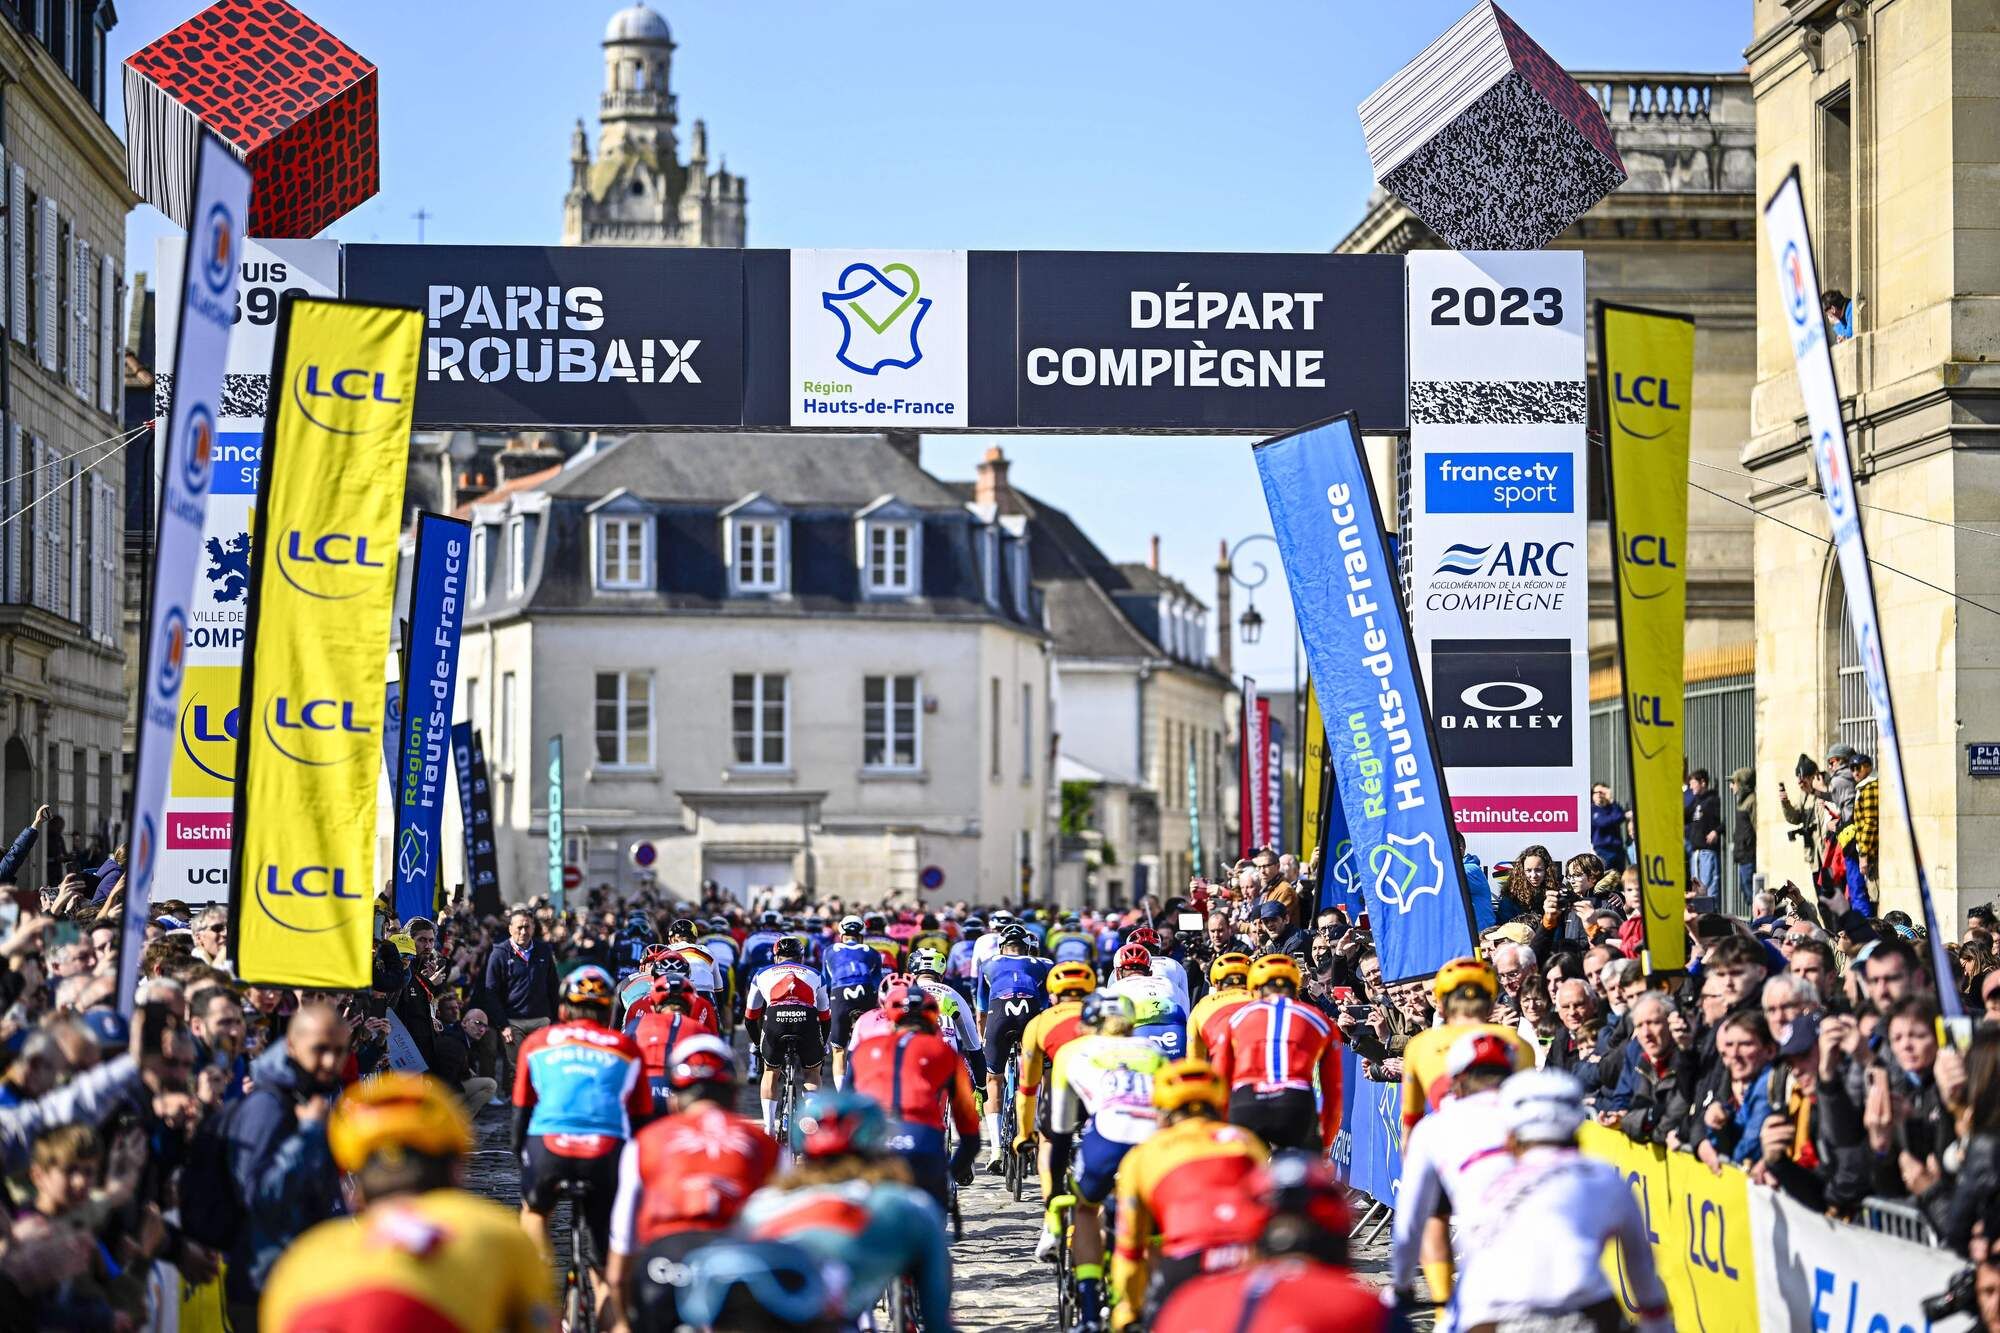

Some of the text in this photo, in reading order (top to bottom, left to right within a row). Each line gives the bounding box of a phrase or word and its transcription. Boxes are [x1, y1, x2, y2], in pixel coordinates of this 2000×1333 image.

[428, 285, 605, 331] PARIS
[1130, 282, 1324, 331] DÉPART
[1430, 287, 1564, 327] 2023
[427, 337, 702, 384] ROUBAIX
[1026, 340, 1326, 388] COMPIÈGNE
[306, 365, 402, 404] LCL
[804, 381, 853, 396] Région
[1614, 372, 1680, 411] LCL
[803, 398, 955, 414] Hauts-de-France
[1493, 483, 1557, 509] sport
[288, 530, 384, 567] LCL
[1487, 541, 1575, 577] ARC
[1622, 531, 1677, 568] LCL
[1426, 589, 1565, 611] COMPIÈGNE
[1429, 580, 1567, 590] AGGLOMÉRATION DE LA RÉGION DE
[193, 611, 244, 623] VILLE DE
[1327, 482, 1425, 810] Hauts-de-France
[421, 539, 462, 807] Hauts-de-France
[275, 697, 371, 733] LCL
[1441, 715, 1563, 729] OAKLEY
[1633, 692, 1674, 727] LCL
[405, 717, 423, 806] Région
[1350, 711, 1386, 820] Région
[1453, 806, 1569, 823] stminute.com
[188, 868, 228, 885] UCI
[266, 865, 363, 899] LCL
[1687, 1192, 1739, 1281] LCL
